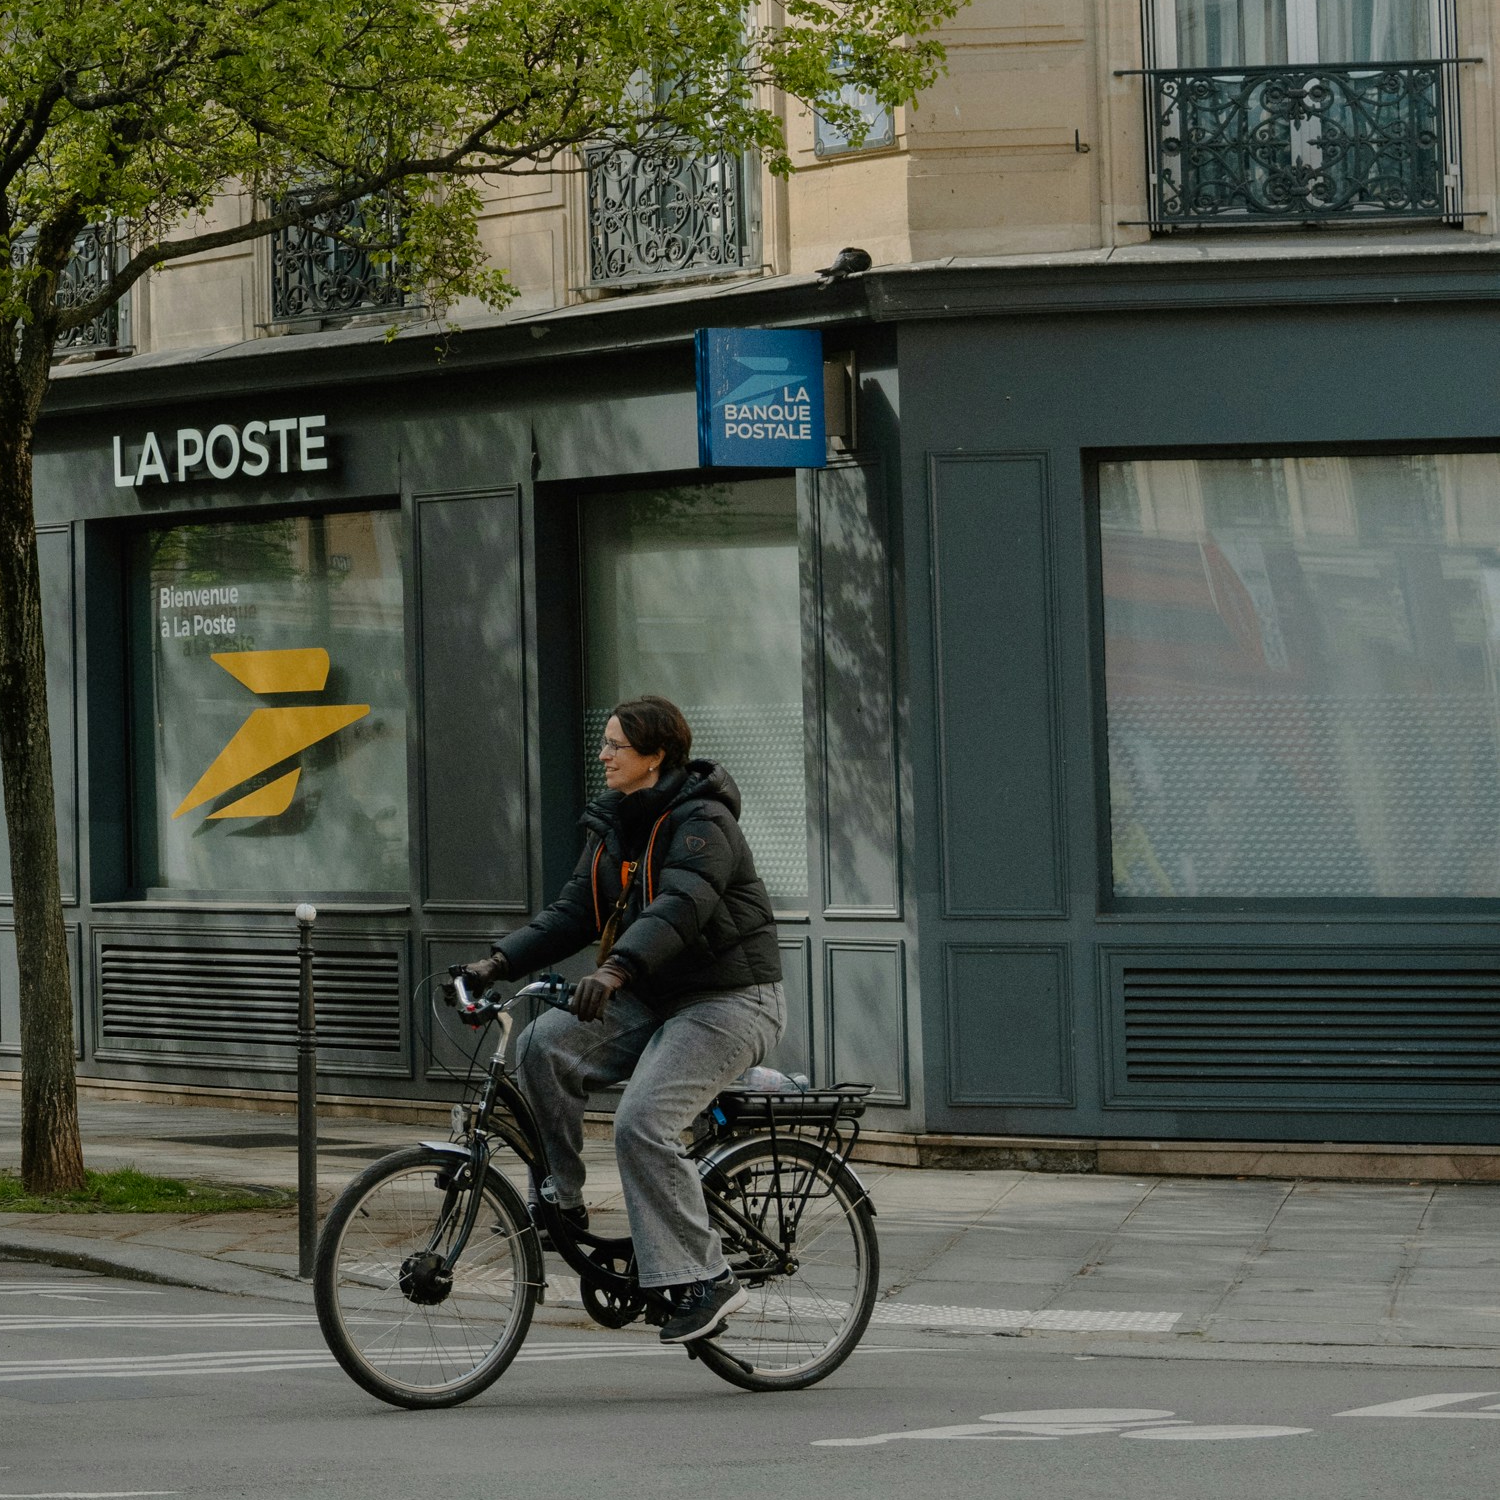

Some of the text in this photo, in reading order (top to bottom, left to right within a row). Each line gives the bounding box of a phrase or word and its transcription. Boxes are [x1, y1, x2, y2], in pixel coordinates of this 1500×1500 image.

[784, 386, 810, 403] LA
[724, 404, 811, 421] BANQUE
[725, 422, 812, 440] POSTALE
[113, 414, 328, 488] LA POSTE
[160, 585, 239, 609] Bienvenue
[161, 614, 236, 638] à La Poste
